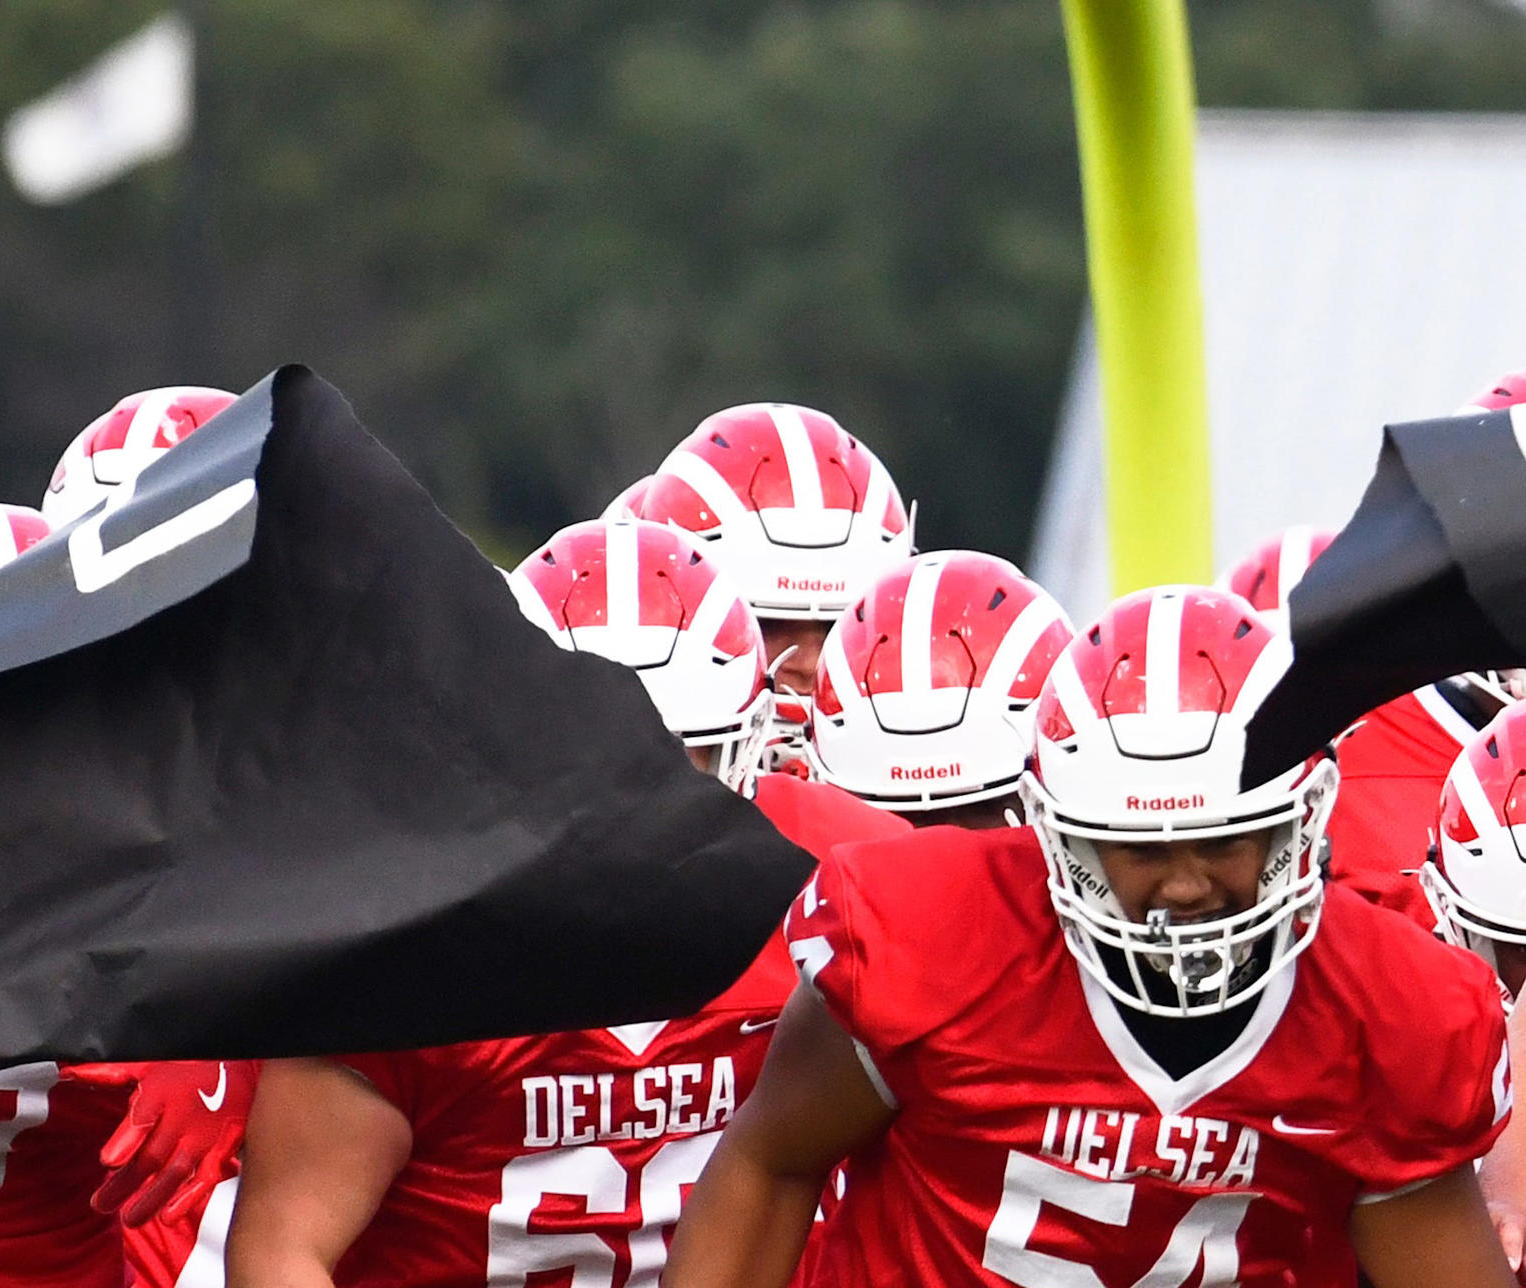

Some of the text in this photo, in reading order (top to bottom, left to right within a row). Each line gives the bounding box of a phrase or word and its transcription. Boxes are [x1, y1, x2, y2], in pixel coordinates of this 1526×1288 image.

[890, 763, 962, 781] Riddell
[1126, 794, 1205, 811] Riddell
[522, 1056, 736, 1147] DELSEA
[1039, 1106, 1260, 1188] DELSEA
